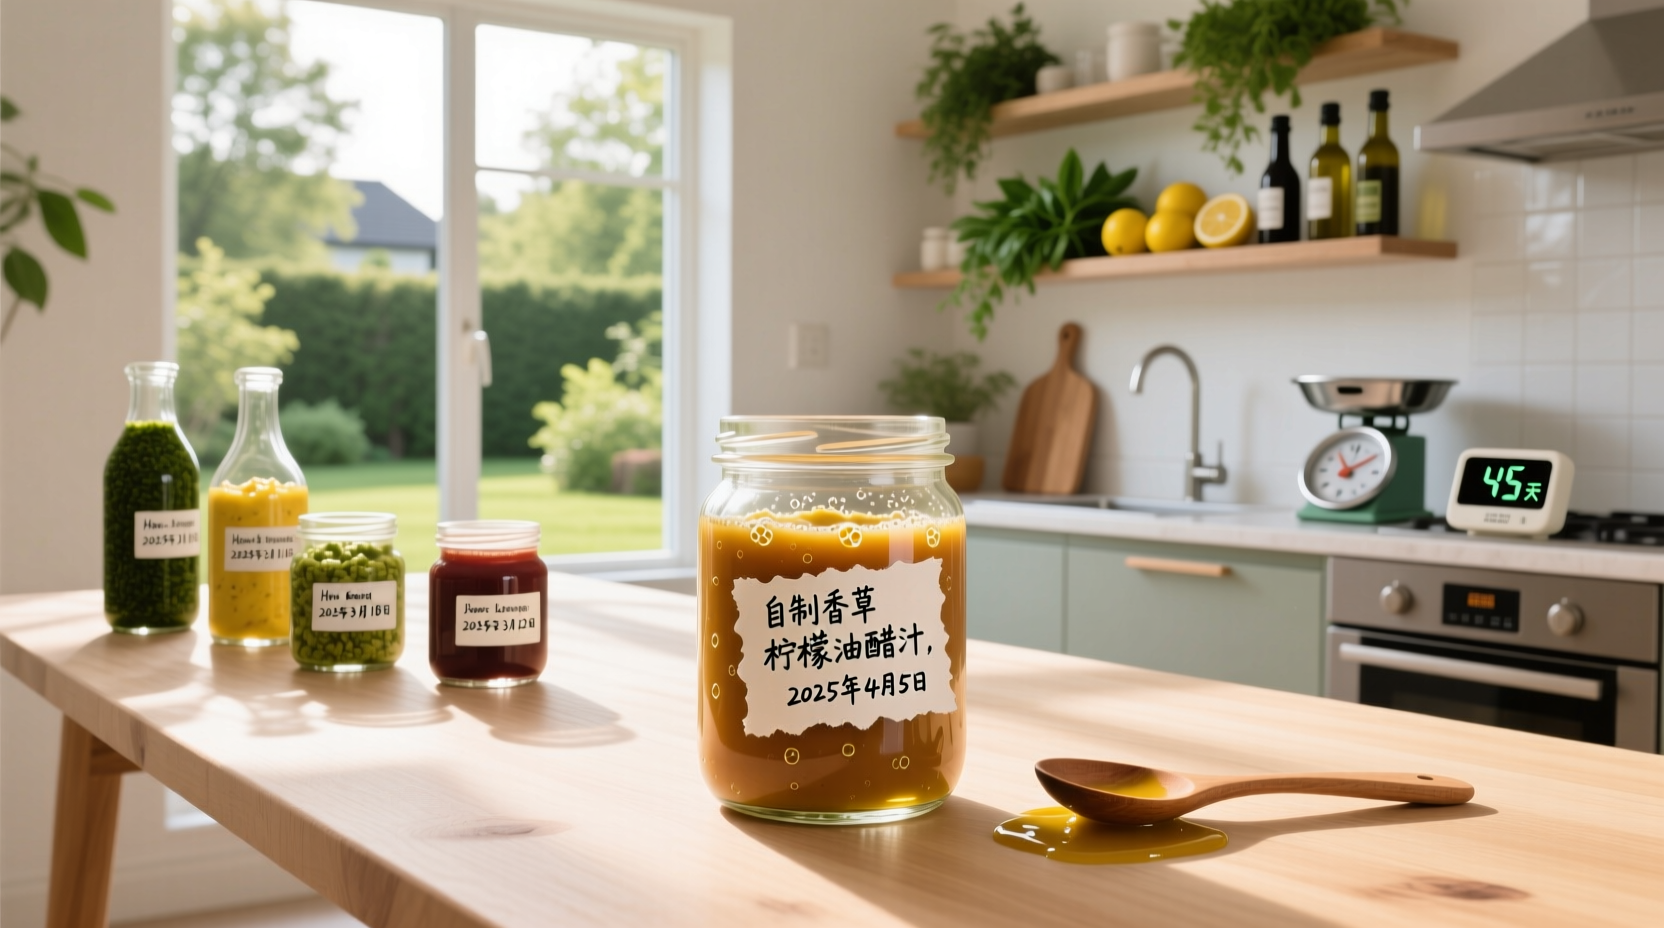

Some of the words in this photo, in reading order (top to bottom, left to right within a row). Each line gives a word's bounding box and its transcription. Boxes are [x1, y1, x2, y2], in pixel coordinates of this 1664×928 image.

[1483, 465, 1542, 502] 45天
[765, 585, 876, 628] 自制香草
[763, 622, 932, 671] 柠檬油醋汁，
[787, 671, 926, 706] 2025年4月5日
